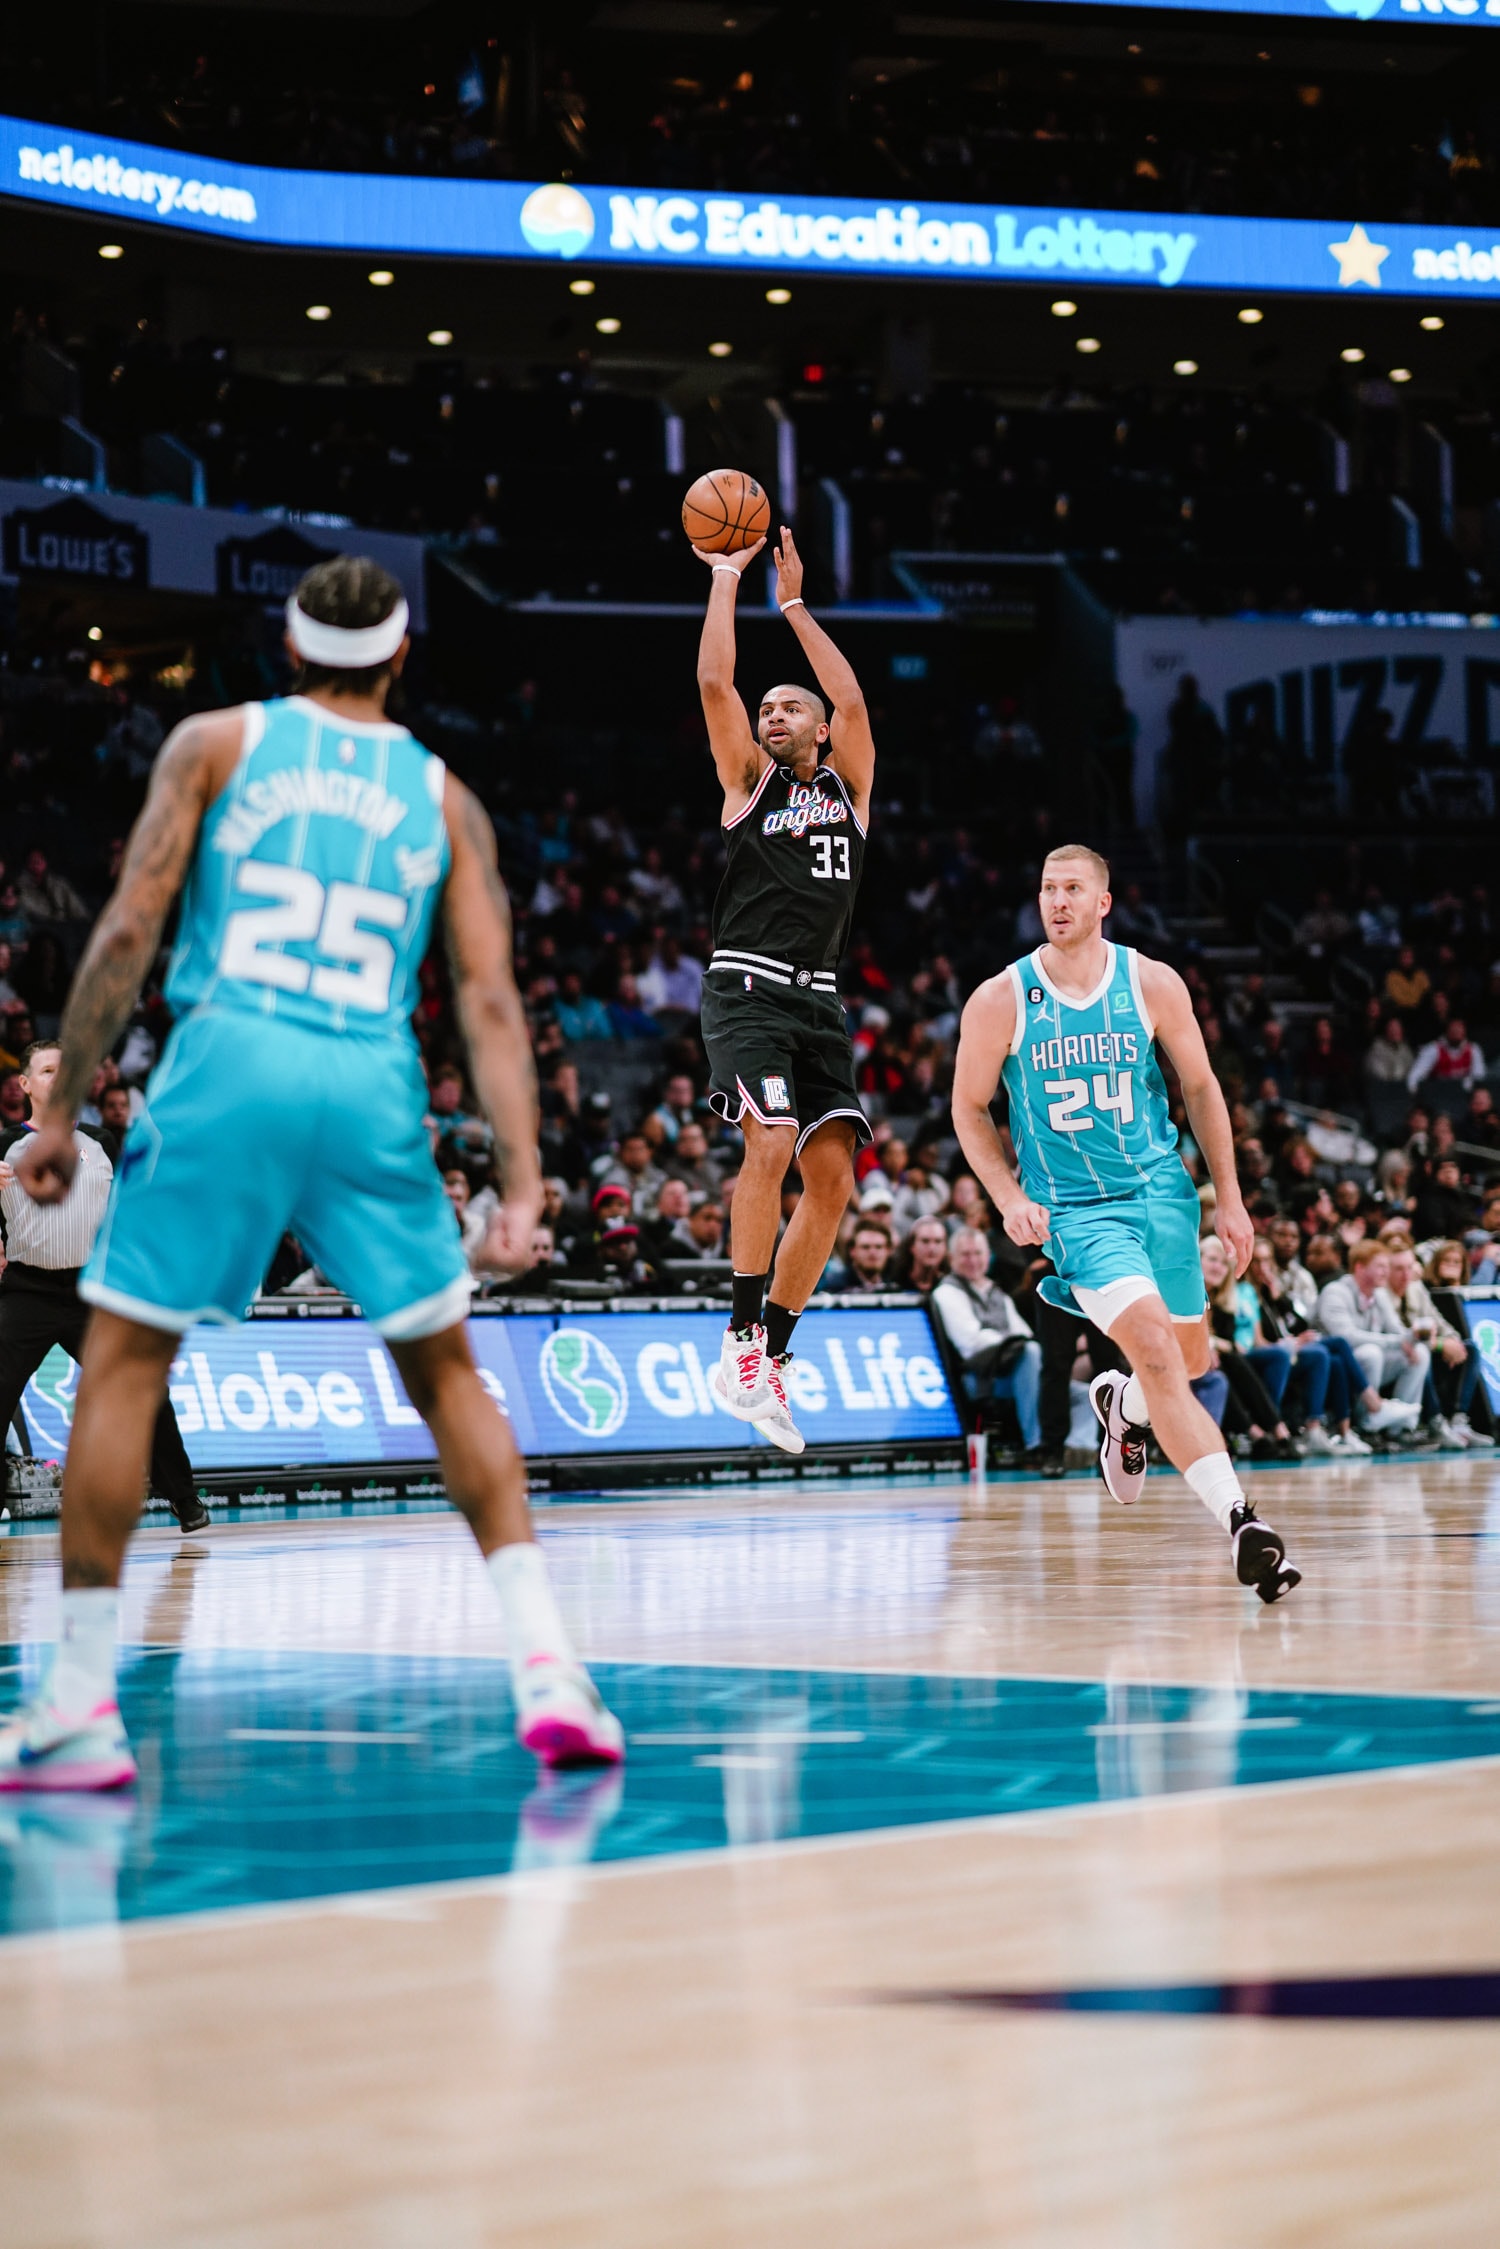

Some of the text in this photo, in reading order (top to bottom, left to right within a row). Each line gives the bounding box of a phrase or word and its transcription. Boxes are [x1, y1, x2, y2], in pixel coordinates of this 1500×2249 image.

[18, 145, 256, 223] nclottery.com
[609, 195, 1197, 286] NC Education Lottery
[762, 798, 847, 836] angeles
[789, 783, 825, 809] los
[809, 835, 851, 881] 33
[219, 858, 408, 1014] 25
[1030, 988, 1042, 1003] 6
[1030, 1032, 1139, 1073] HORNETS
[1043, 1069, 1135, 1132] 24
[636, 1332, 948, 1418] Gle Life
